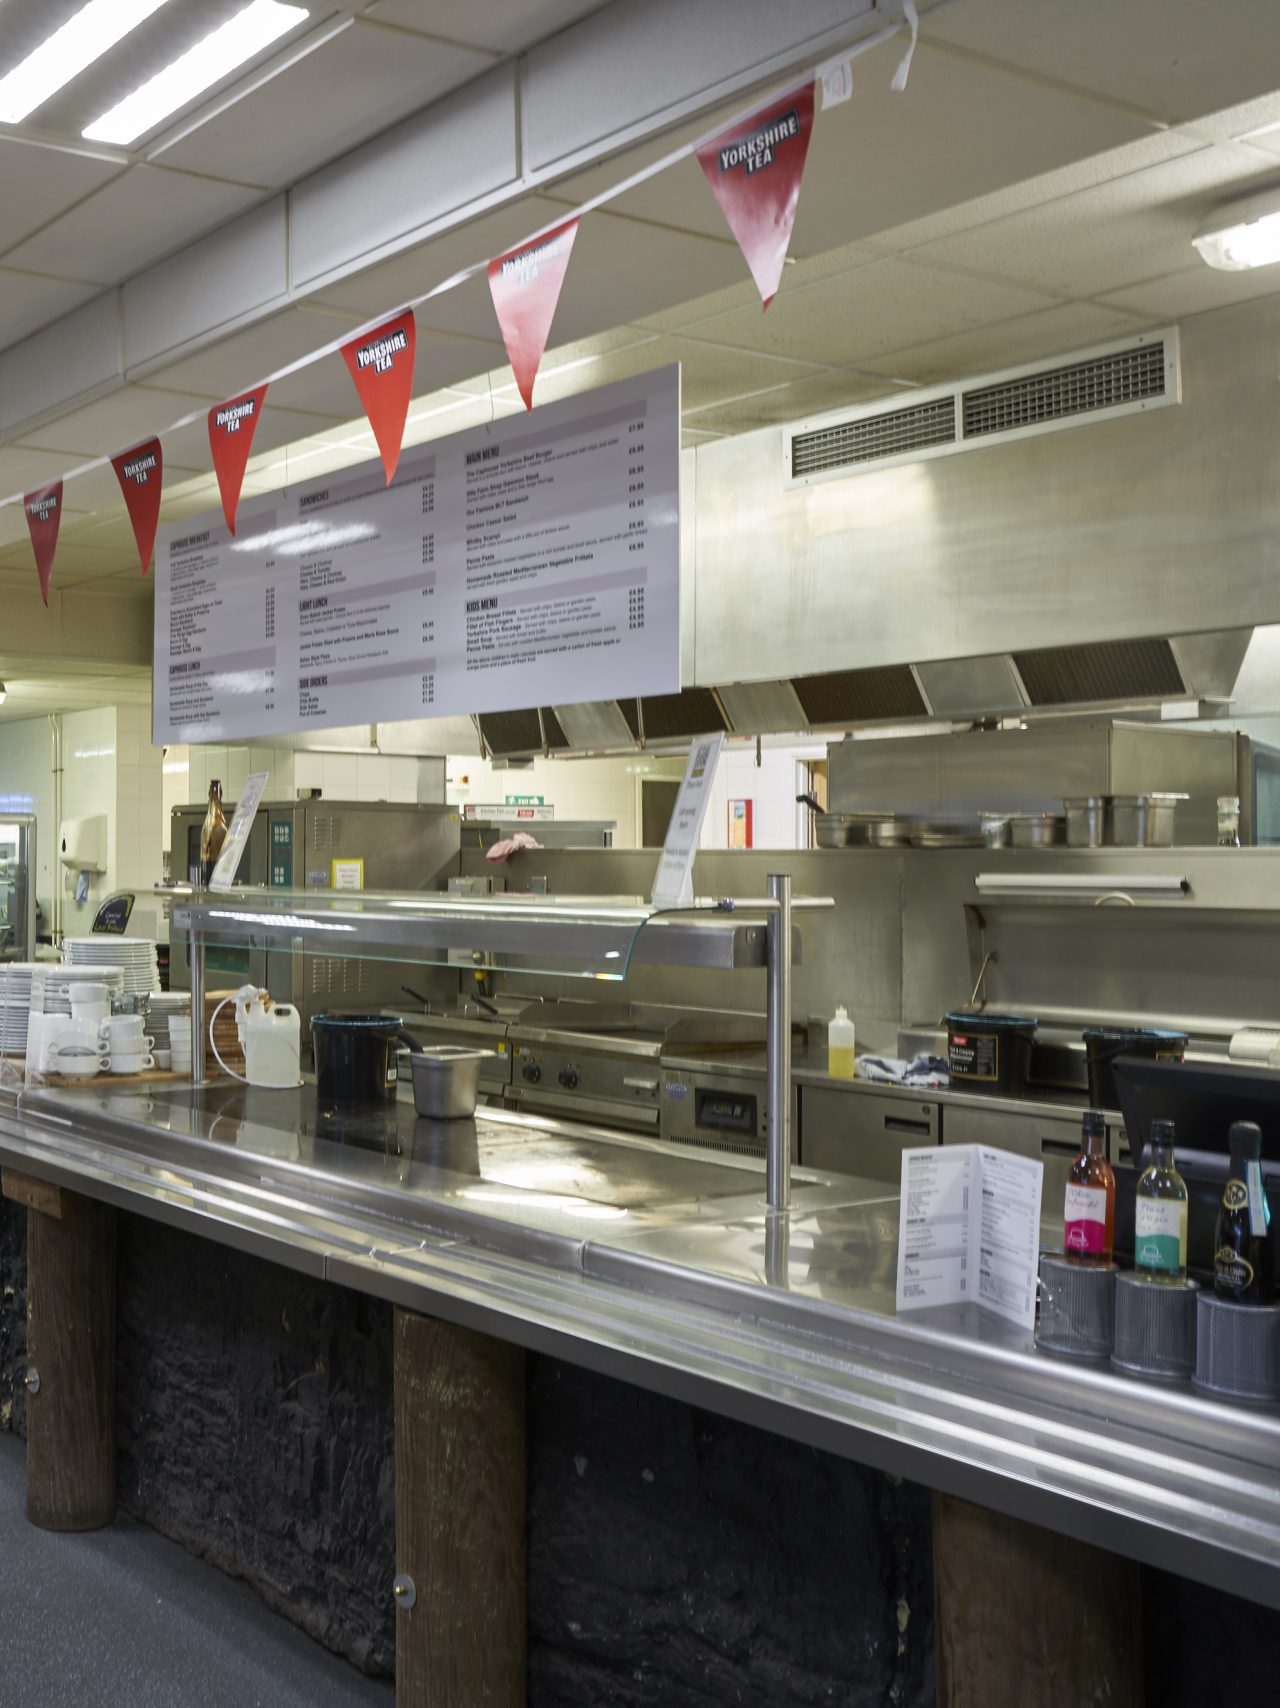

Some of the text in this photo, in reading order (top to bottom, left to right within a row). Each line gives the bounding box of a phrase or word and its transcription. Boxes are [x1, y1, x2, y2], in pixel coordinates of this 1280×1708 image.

[721, 116, 797, 170] YORKSHIRE
[746, 150, 772, 173] TEA
[357, 332, 407, 367] YORKSHIRE
[375, 353, 393, 374] TEA
[217, 402, 255, 426] YORKSHIRE
[226, 418, 240, 433] TEA
[466, 446, 499, 464] MAIN MENU
[124, 455, 157, 478] YORKSHIRE
[136, 470, 148, 485] TEA
[30, 496, 57, 514] YORKSHIRE
[39, 510, 49, 521] TEA
[299, 596, 327, 611] LIGHT LUNCH
[466, 598, 497, 612] KIDS MENU
[299, 675, 327, 687] SIDE ORDERS
